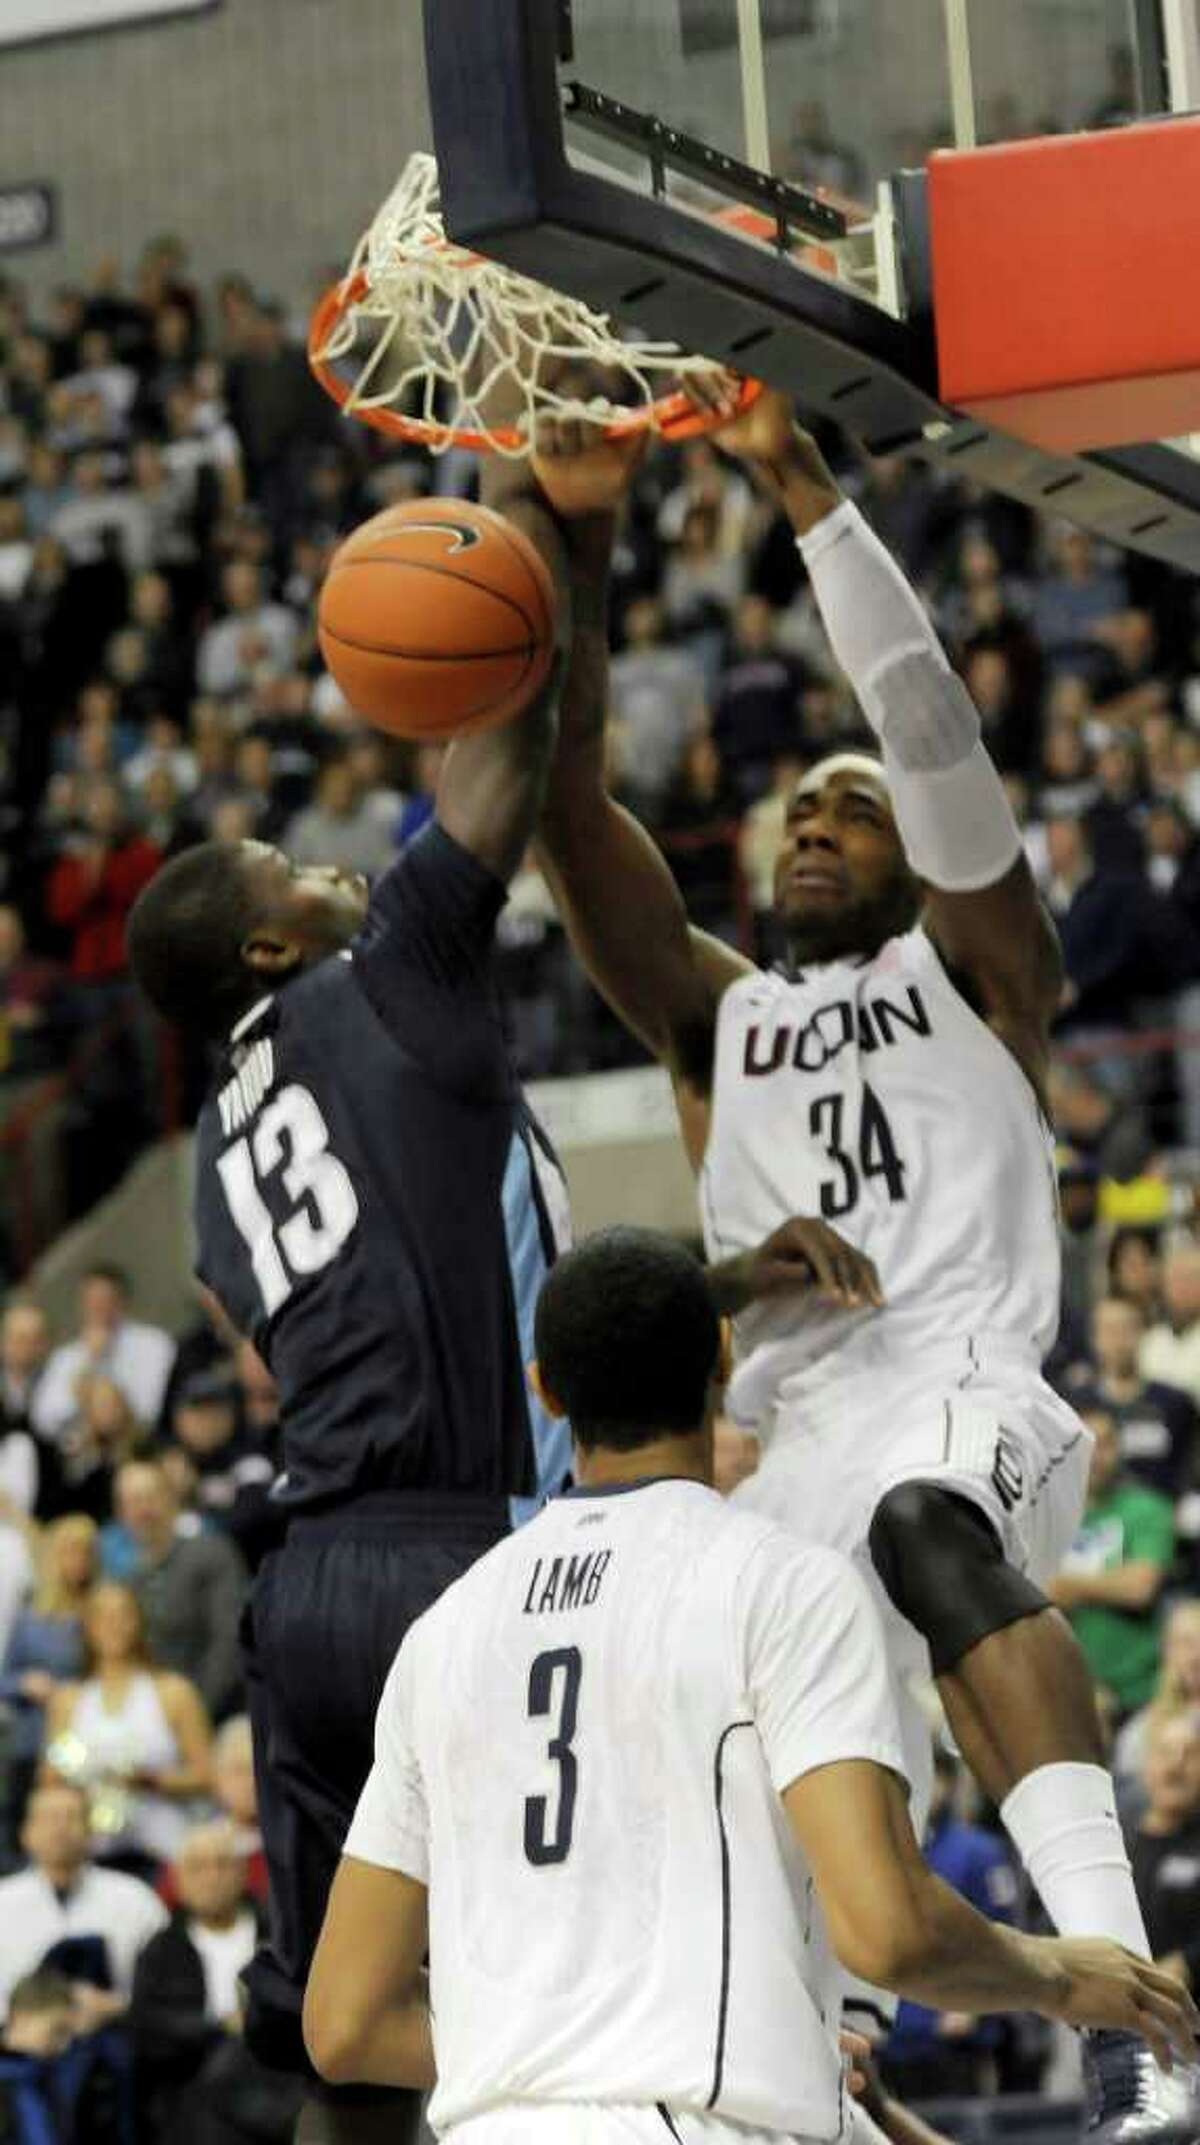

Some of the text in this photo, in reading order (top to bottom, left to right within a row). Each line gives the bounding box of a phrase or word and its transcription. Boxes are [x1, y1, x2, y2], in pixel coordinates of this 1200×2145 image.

[216, 1084, 358, 1317] 13
[810, 1079, 905, 1219] 34
[523, 1548, 612, 1613] LAMB
[524, 1646, 582, 1866] 3
